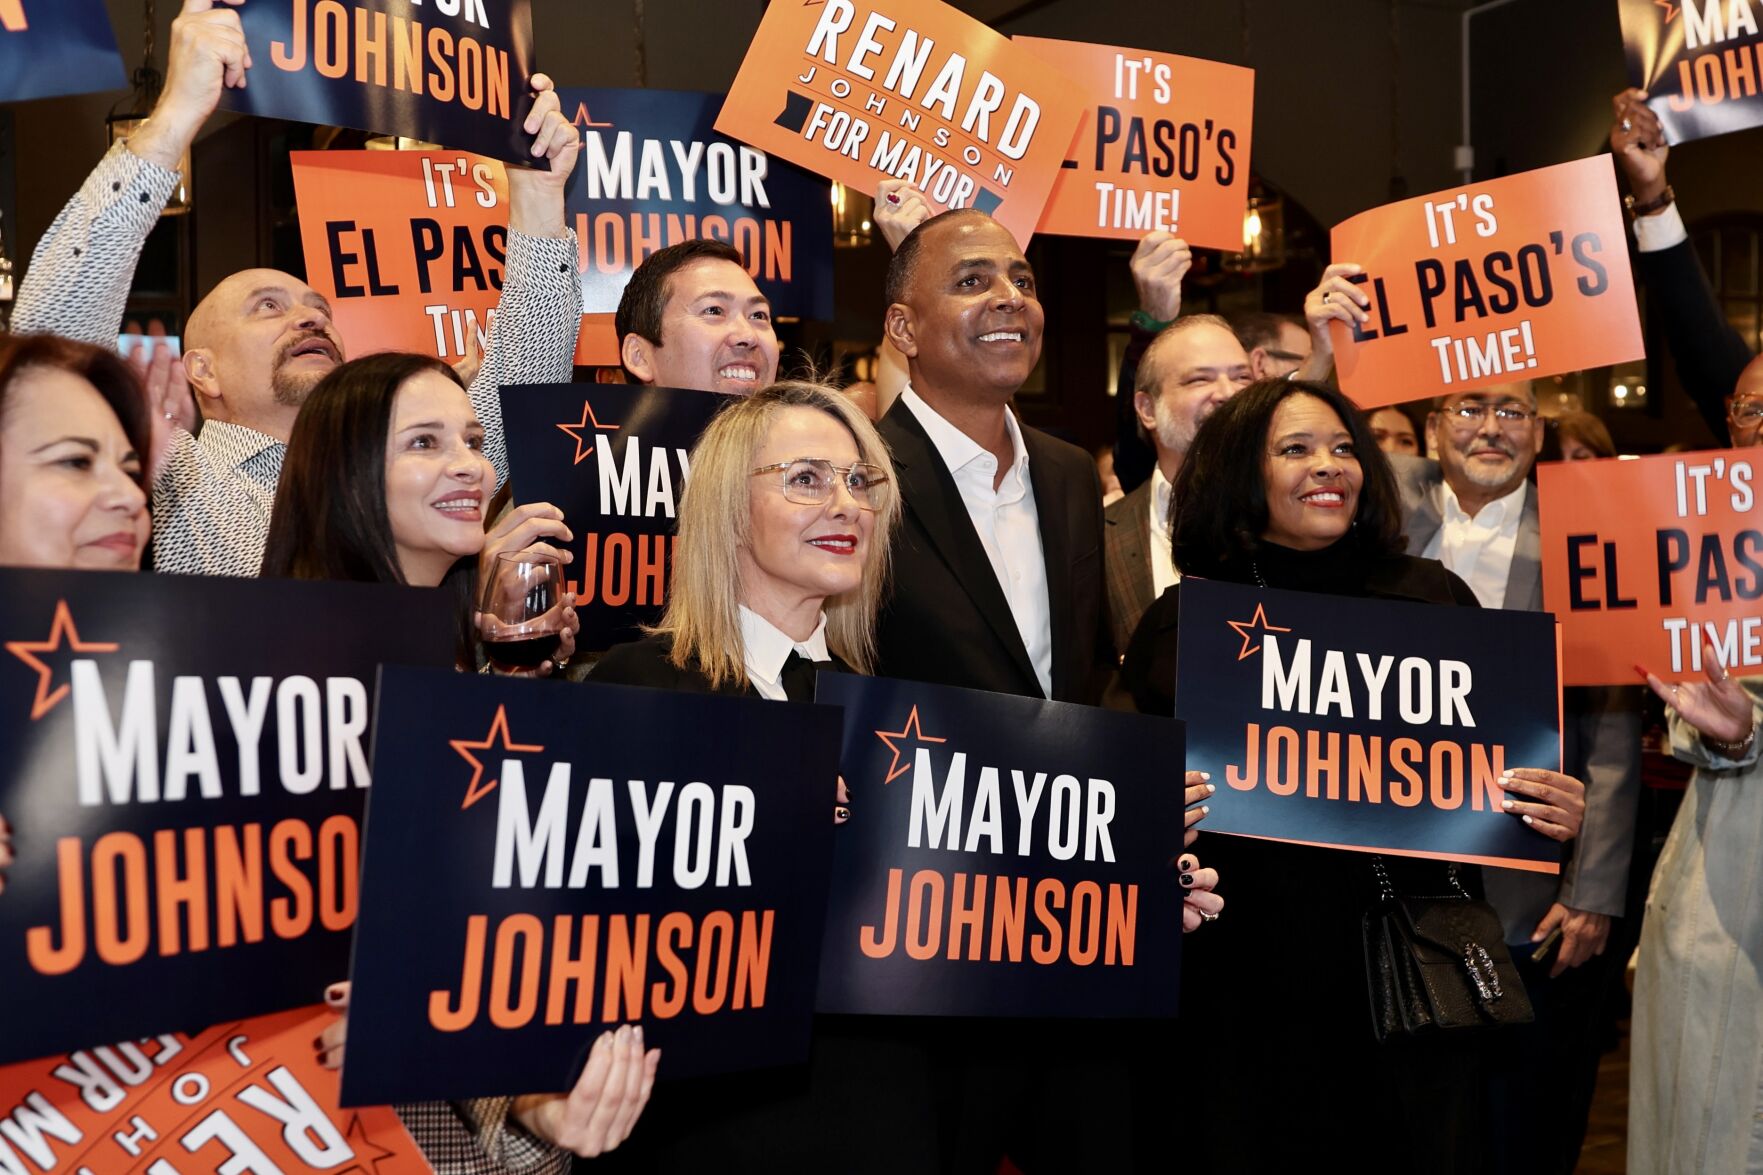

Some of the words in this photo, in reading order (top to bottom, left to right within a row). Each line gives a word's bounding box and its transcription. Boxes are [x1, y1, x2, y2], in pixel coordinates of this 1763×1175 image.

[270, 0, 511, 120] JOHNSON
[804, 0, 1042, 161] RENARD
[1114, 53, 1172, 105] IT'S
[586, 130, 771, 209] MAYOR
[797, 65, 1014, 187] JOHNSON
[803, 102, 871, 161] FOR
[868, 129, 976, 211] MAYOR
[1094, 104, 1237, 187] PASO'S
[420, 156, 498, 209] IT'S
[1095, 182, 1180, 233] TIME!
[1423, 192, 1498, 249] IT'S
[325, 219, 400, 299] EL
[409, 217, 508, 294] PAS
[1346, 272, 1409, 344] EL
[1414, 230, 1609, 330] PASO'S
[1430, 319, 1539, 385] TIME!
[1674, 457, 1755, 518] IT'S
[1566, 533, 1638, 613] EL
[1261, 633, 1477, 728] MAYOR
[70, 659, 373, 807] MAYOR
[1225, 723, 1505, 814] JOHNSON
[492, 758, 756, 890] MAYOR
[907, 747, 1117, 864] MAYOR
[25, 814, 360, 977] JOHNSO
[859, 867, 1140, 967] JOHNSON
[427, 909, 775, 1033] JOHNSON
